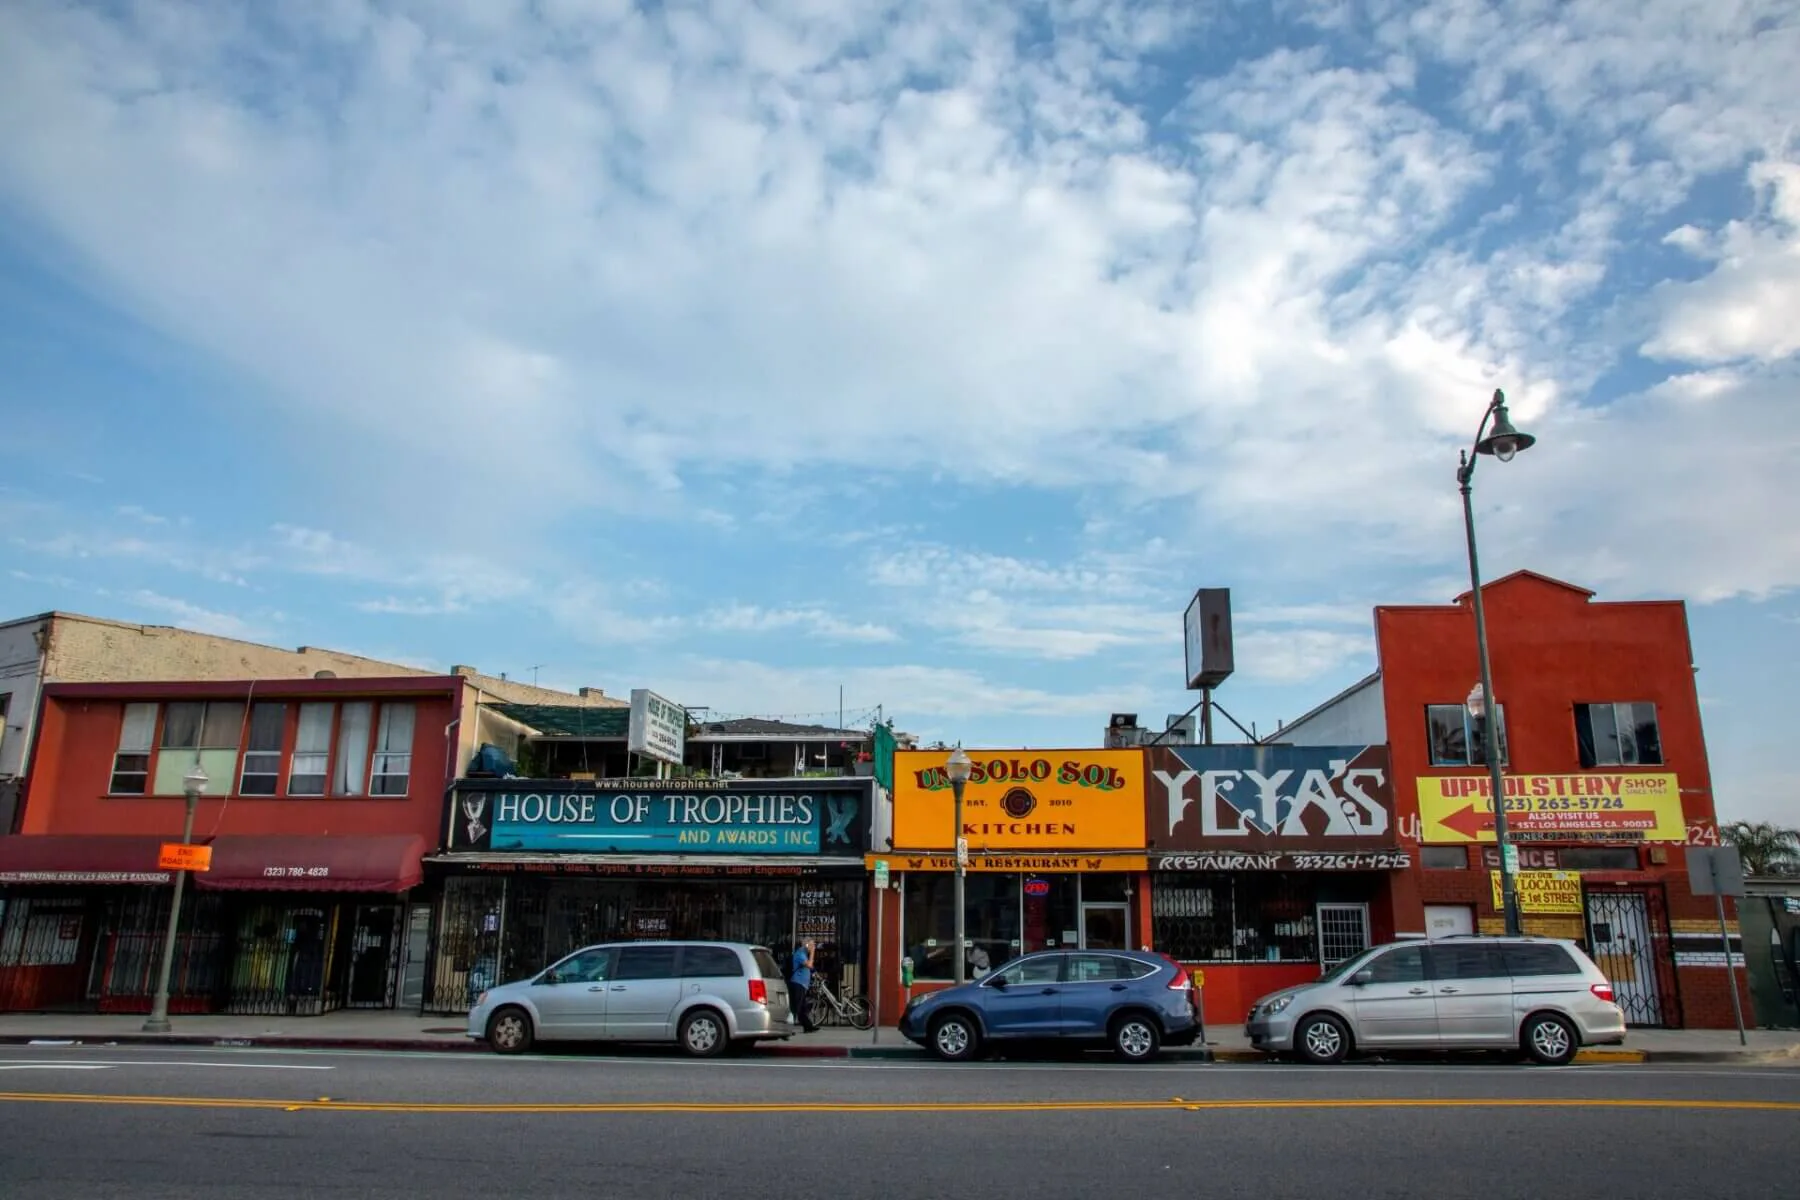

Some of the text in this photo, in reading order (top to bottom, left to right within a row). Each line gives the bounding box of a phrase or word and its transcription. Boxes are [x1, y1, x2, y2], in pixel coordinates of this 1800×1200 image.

[967, 759, 1052, 784] SOLO
[1058, 761, 1126, 791] SOL
[595, 780, 729, 790] www.houseoftrophies.net
[1440, 776, 1667, 797] UPHOLSTERY SHOP
[966, 799, 1072, 807] EST. 2010
[1152, 760, 1389, 837] YEYA'S
[1486, 797, 1624, 811] (23) 263-5724
[497, 793, 814, 825] HOUSE OF TROPHIES
[1528, 811, 1600, 820] ALSO VISIT US
[963, 823, 1076, 835] KITCHEN
[1539, 821, 1556, 829] LOS
[1559, 820, 1601, 829] ANGELES
[678, 830, 818, 845] AND AWARDS INC.
[931, 858, 1080, 868] VEGN RESTAURANT
[1486, 851, 1556, 867] SNCE
[263, 867, 286, 877] (323)
[680, 866, 715, 874] Awards
[1521, 879, 1580, 890] LOCATION
[1528, 893, 1541, 902] 1st
[1543, 892, 1580, 903] STREET
